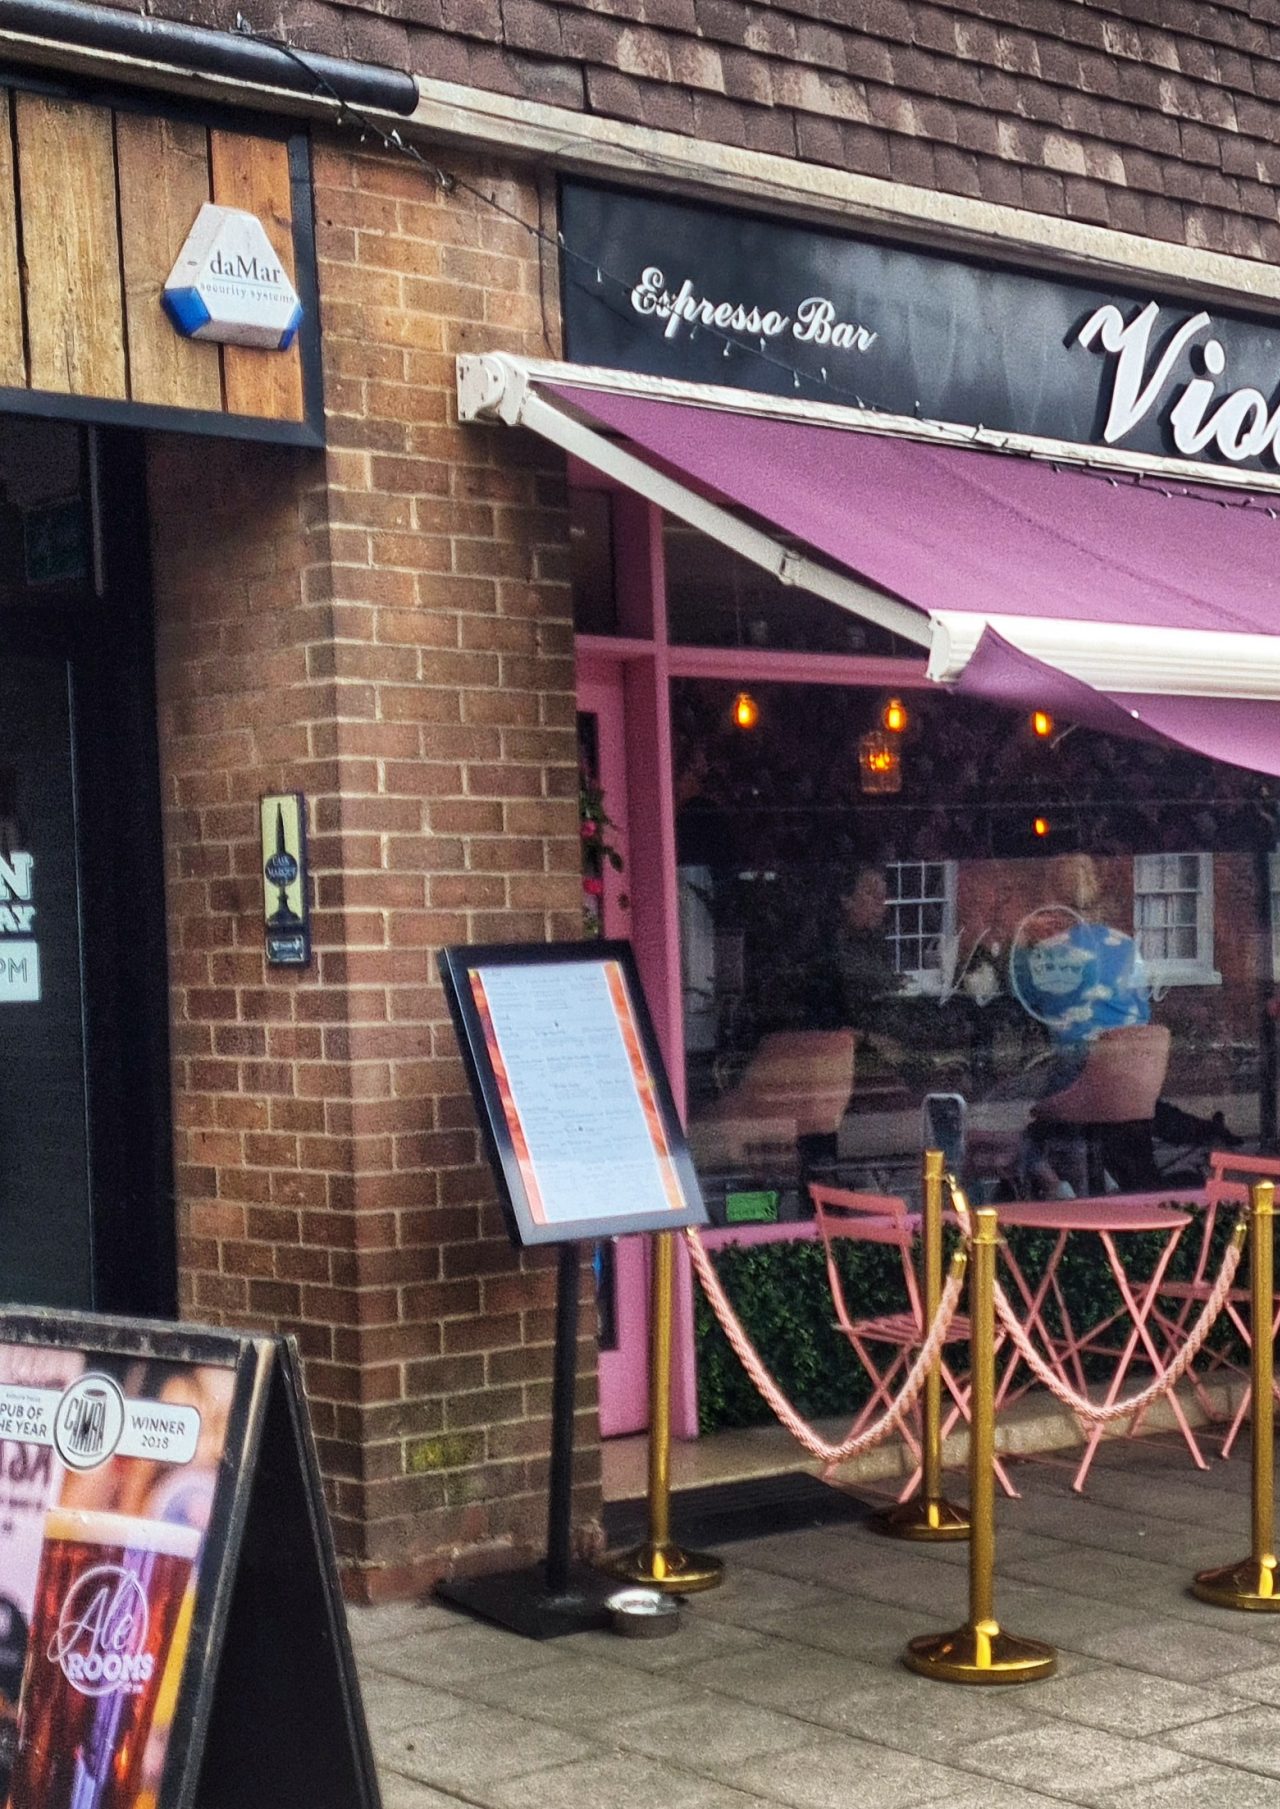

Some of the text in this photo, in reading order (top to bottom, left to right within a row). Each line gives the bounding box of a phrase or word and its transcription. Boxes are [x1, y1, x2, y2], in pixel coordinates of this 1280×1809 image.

[210, 250, 281, 284] daMar
[200, 282, 295, 303] security systems
[631, 266, 880, 351] Espresso Bar
[0, 1402, 44, 1421] PUB OF
[0, 1419, 47, 1439] HE YEAR
[131, 1415, 186, 1436] WINNER
[141, 1434, 170, 1450] 2018
[47, 1571, 136, 1664] Ale
[67, 1652, 155, 1682] ROOMS
